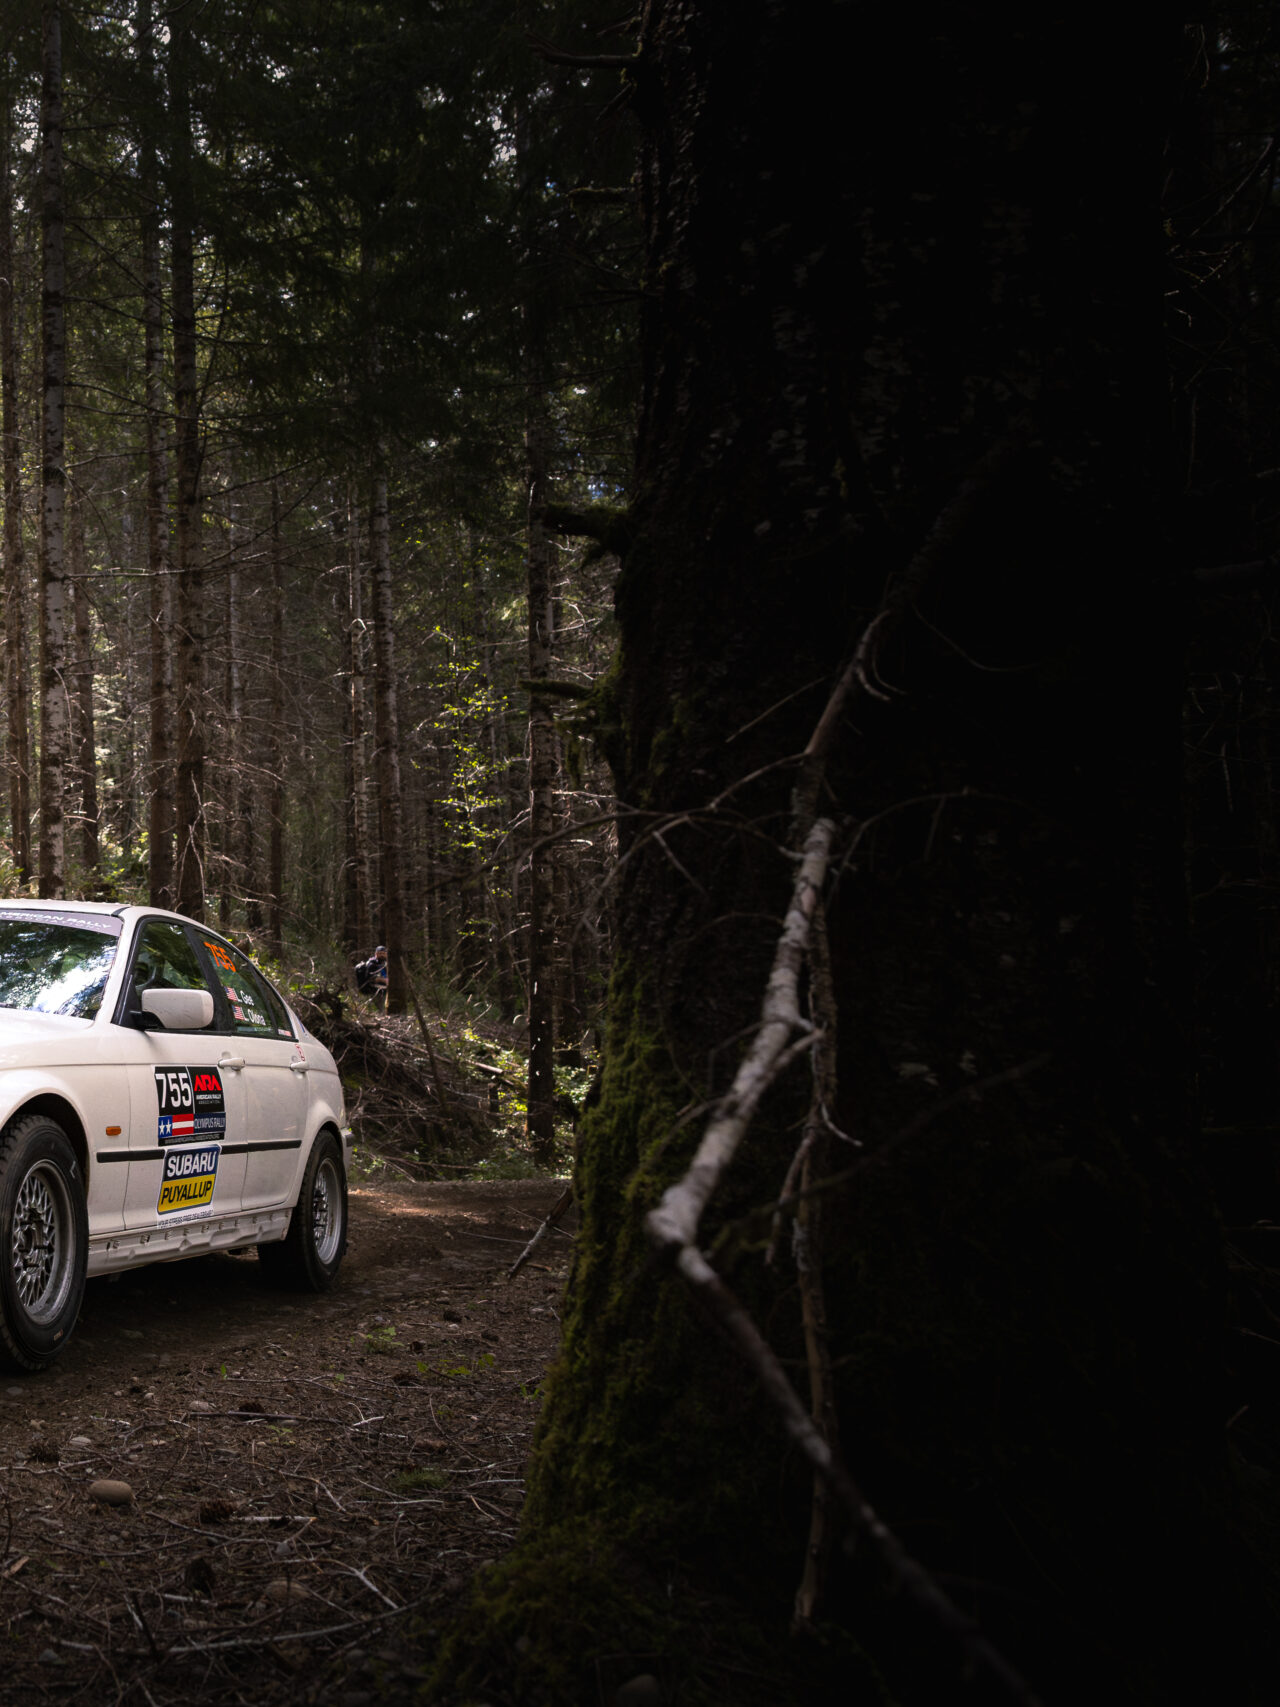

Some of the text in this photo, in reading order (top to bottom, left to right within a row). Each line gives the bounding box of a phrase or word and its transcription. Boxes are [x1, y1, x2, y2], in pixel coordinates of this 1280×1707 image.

[66, 918, 112, 929] RALLY
[203, 941, 237, 973] 755
[155, 1073, 192, 1108] 755
[194, 1074, 222, 1091] ARA
[194, 1117, 226, 1129] OLYMPUS RALLY
[167, 1152, 217, 1177] SUBARU
[161, 1180, 212, 1204] PUYALLUP
